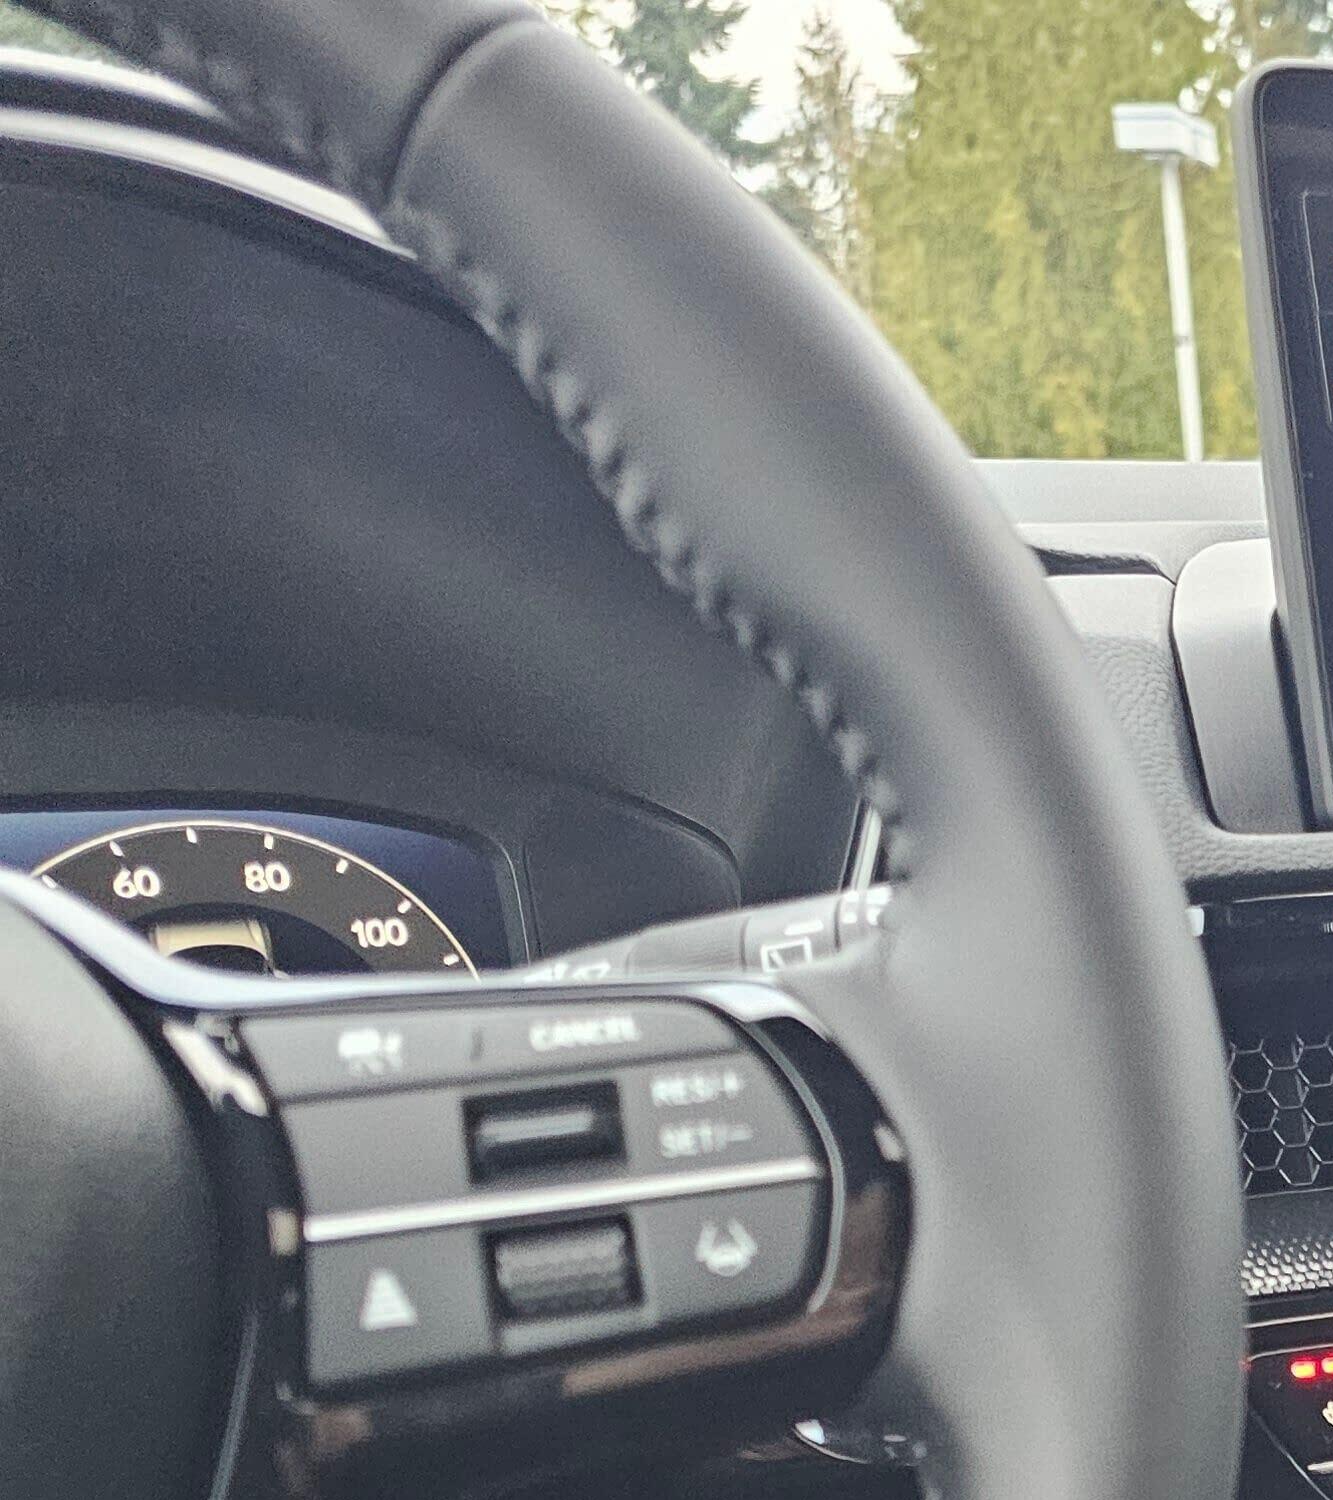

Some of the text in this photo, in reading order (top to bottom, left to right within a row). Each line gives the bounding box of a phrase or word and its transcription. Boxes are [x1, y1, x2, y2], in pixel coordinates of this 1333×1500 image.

[112, 865, 162, 899] 60
[243, 861, 291, 893] 80
[350, 917, 409, 948] 100
